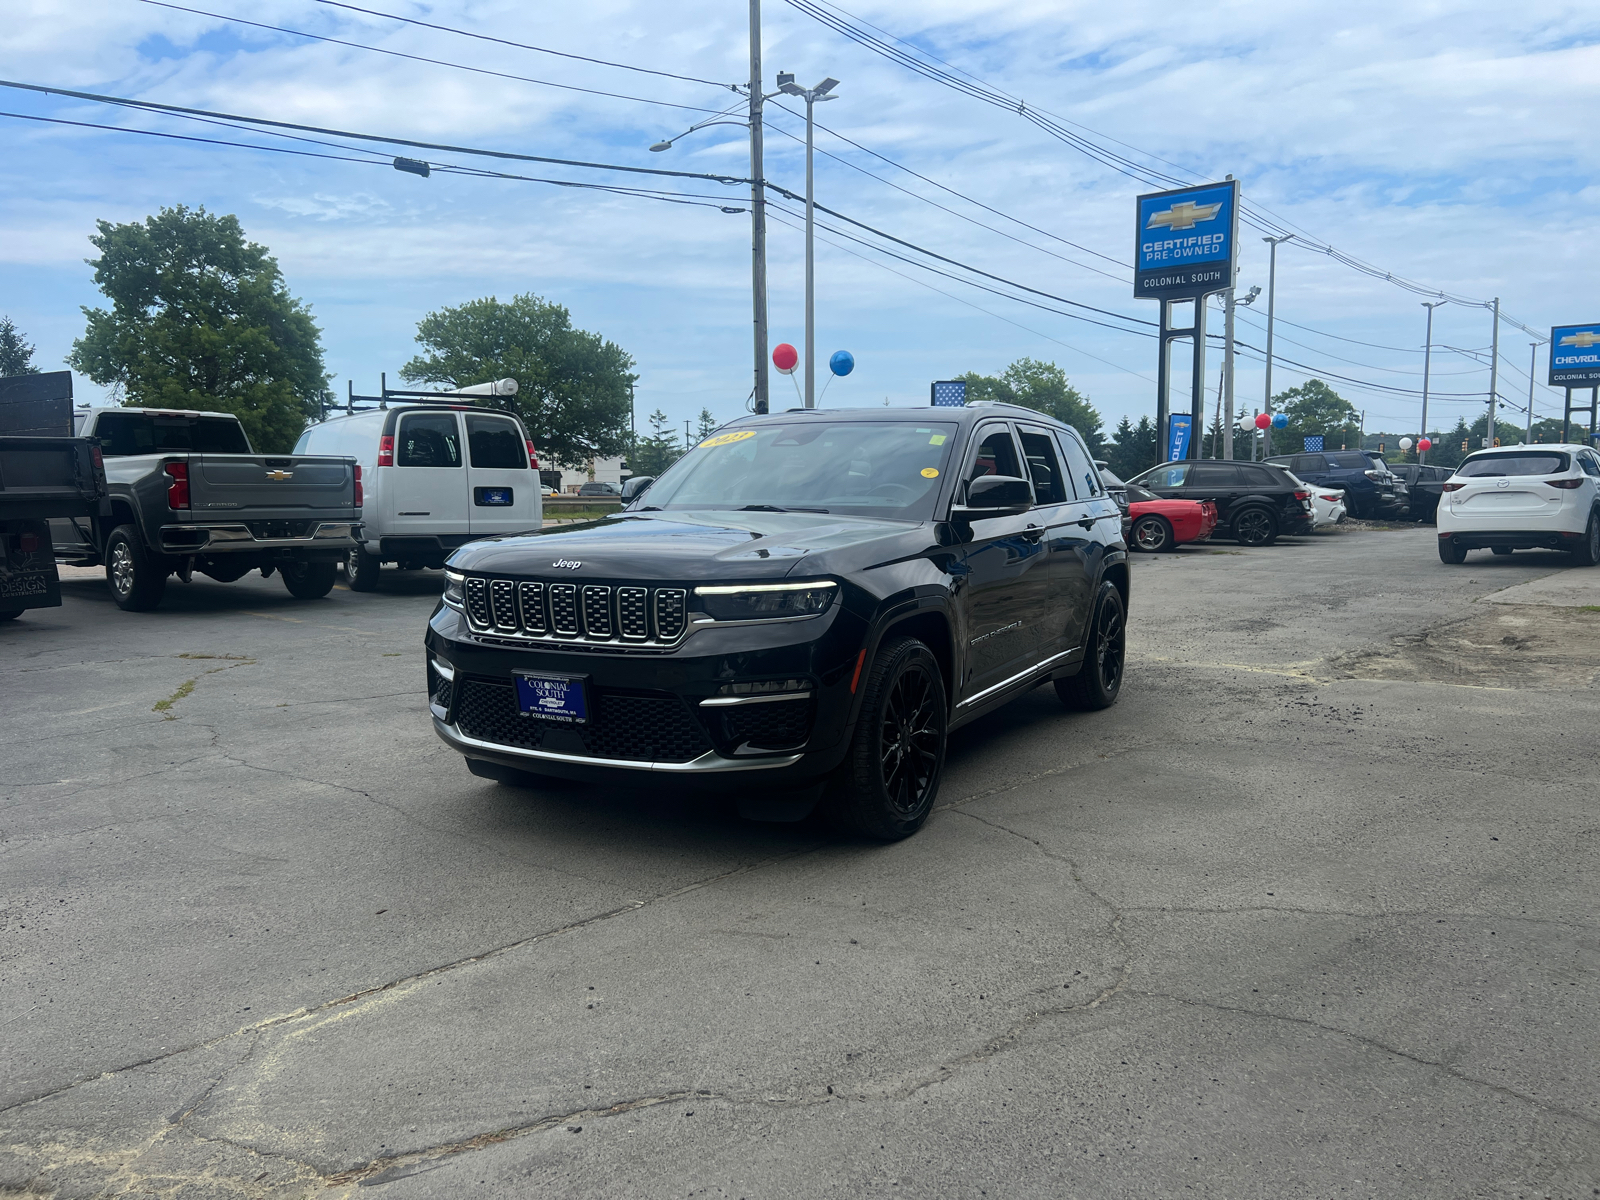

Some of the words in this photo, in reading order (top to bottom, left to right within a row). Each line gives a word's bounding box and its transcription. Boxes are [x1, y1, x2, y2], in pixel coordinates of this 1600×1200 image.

[1142, 233, 1225, 252] CERTIFIED
[1146, 244, 1220, 261] PRE-OWNED
[1143, 275, 1186, 287] COLONIAL
[1191, 271, 1220, 283] SOUTH
[552, 558, 582, 570] Jeep
[1, 579, 47, 593] DESIGN
[2, 589, 47, 598] CONSTRUCTION
[528, 680, 570, 691] COLONIAL
[535, 688, 565, 699] SOUTH
[532, 713, 557, 721] COLONIAL
[556, 715, 573, 723] SOUTH
